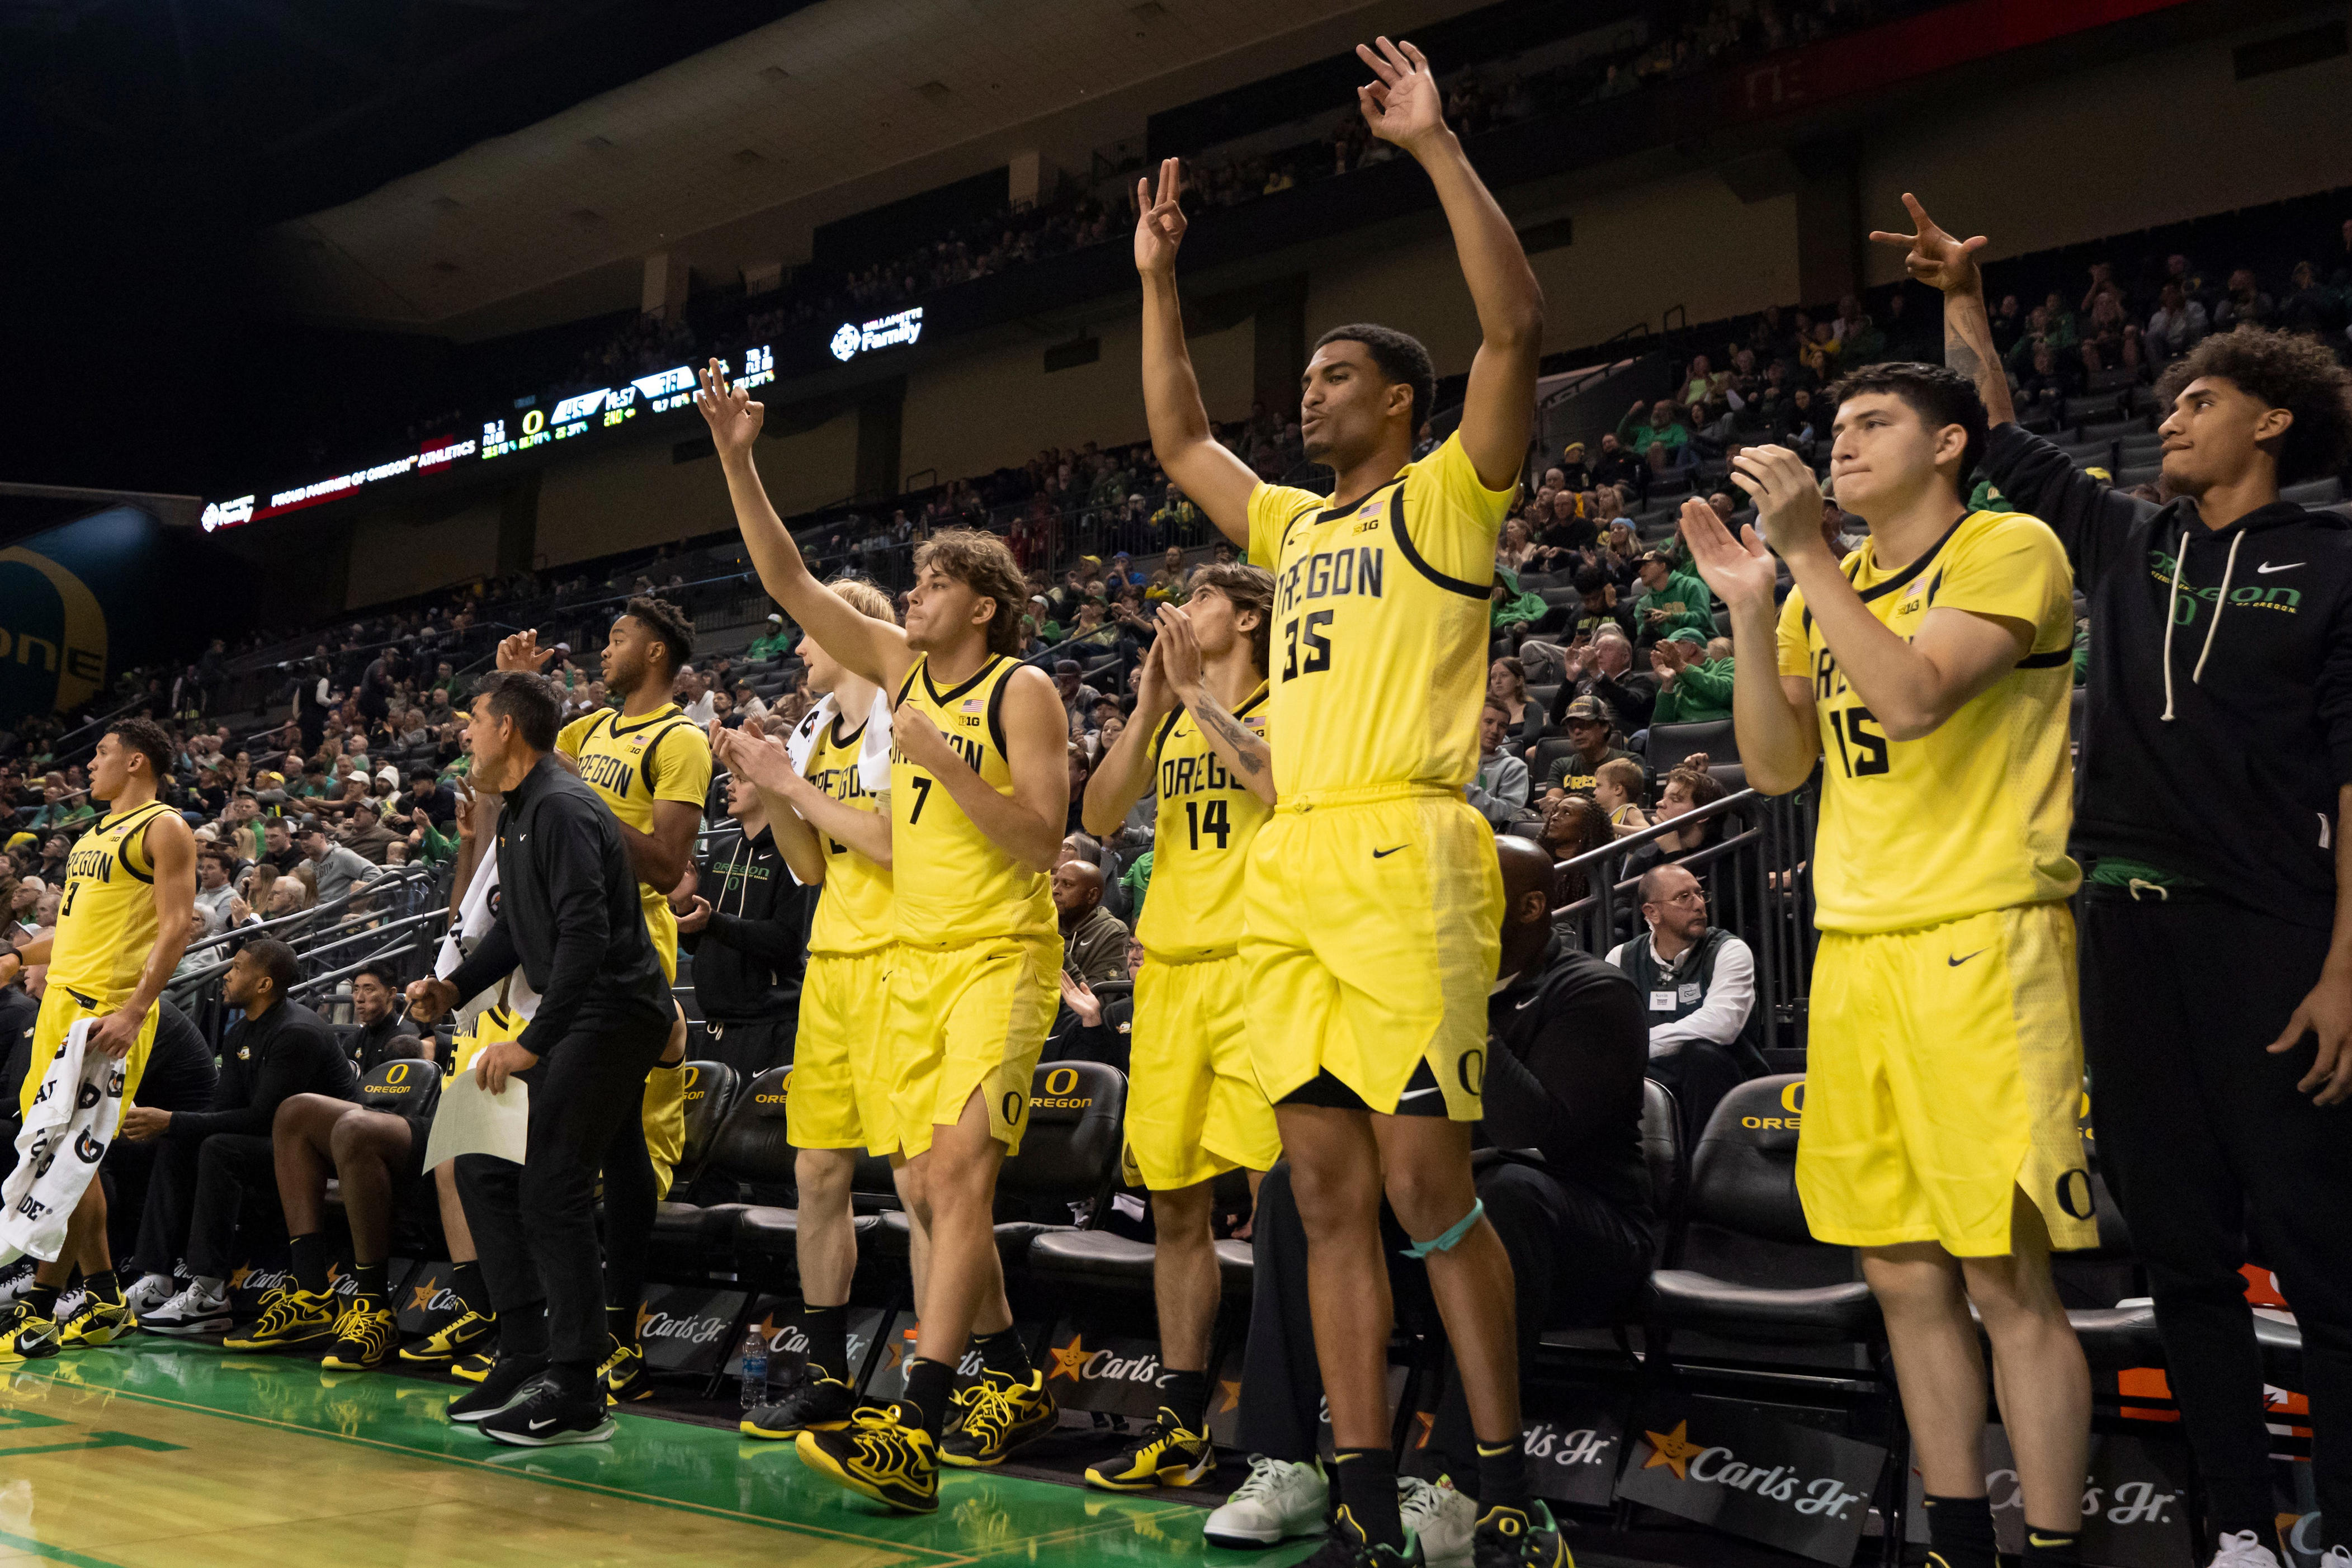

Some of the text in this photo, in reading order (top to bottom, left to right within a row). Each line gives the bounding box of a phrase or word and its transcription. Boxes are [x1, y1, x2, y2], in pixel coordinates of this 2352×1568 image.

[862, 321, 922, 351] Family
[271, 488, 306, 507] PROUD
[306, 475, 351, 498] PARTNER
[351, 470, 366, 486] OF
[418, 440, 475, 468] ATHLETICS
[1282, 609, 1334, 684] 35
[1829, 706, 1890, 778] 15
[578, 754, 634, 799] REGON
[909, 776, 932, 825] 7
[1186, 800, 1230, 851] 14
[65, 849, 114, 884] REGON
[62, 881, 81, 917] 3
[1045, 1068, 1079, 1095] O
[1029, 1097, 1093, 1108] REGON
[642, 1312, 727, 1344] Carl's Jr.
[1083, 1349, 1160, 1382] Carl's
[1555, 1428, 1610, 1466] Jr.
[1689, 1446, 1800, 1503] Carl's
[1793, 1477, 1860, 1520] Jr.
[2107, 1482, 2176, 1524] Jr.
